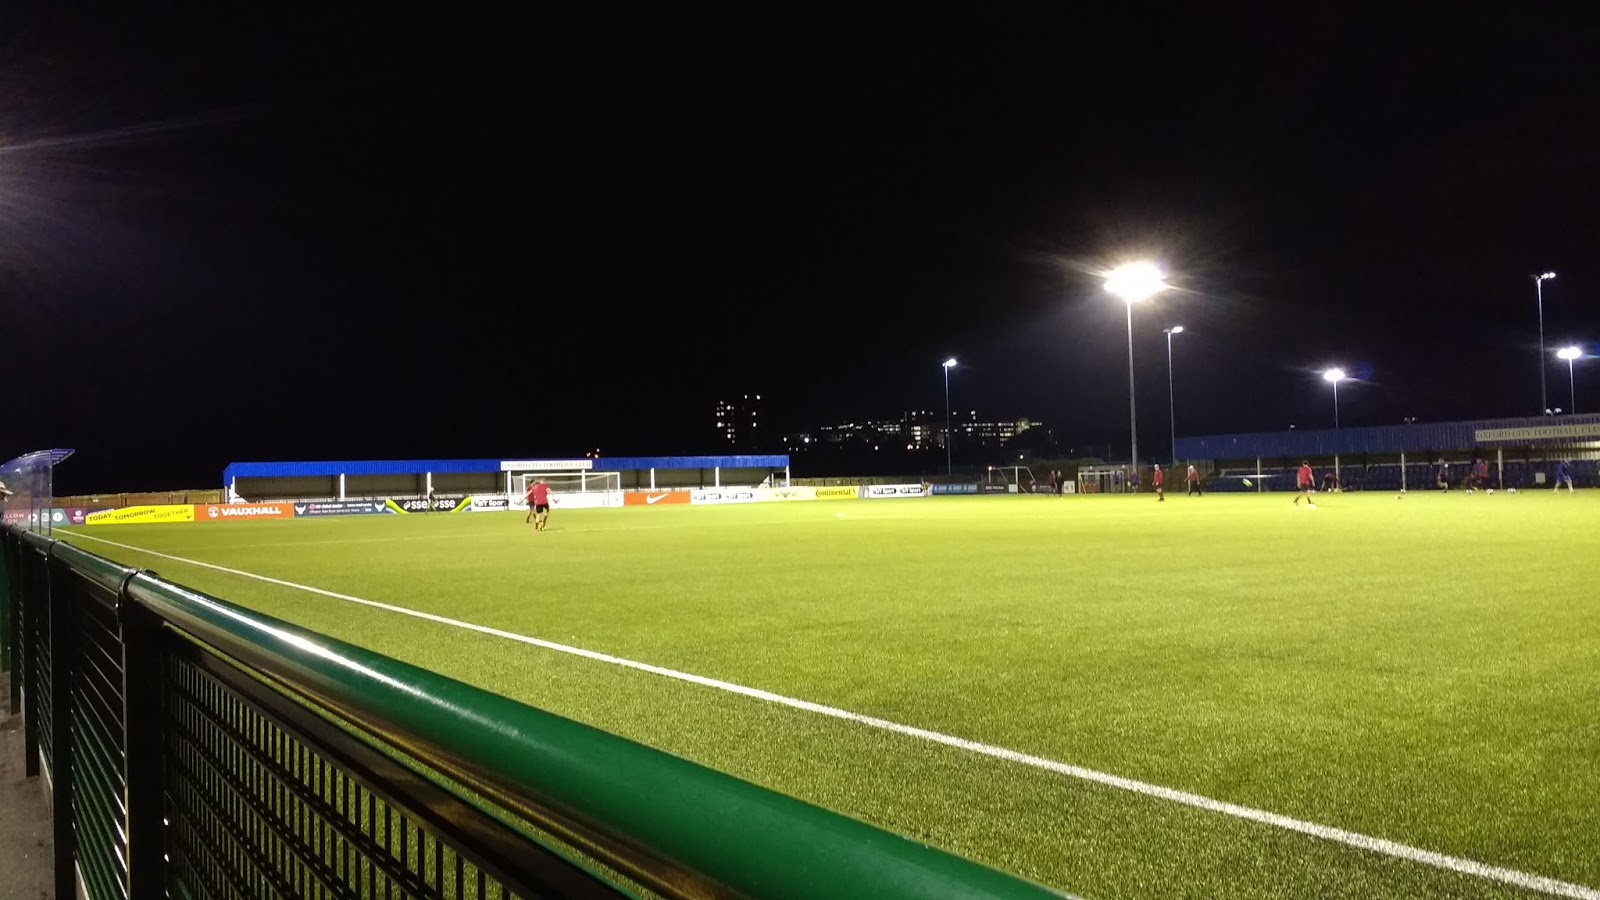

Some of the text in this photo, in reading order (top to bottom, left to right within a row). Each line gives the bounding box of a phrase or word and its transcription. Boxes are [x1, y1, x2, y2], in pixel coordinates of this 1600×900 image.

[1581, 425, 1600, 433] CLU
[815, 488, 851, 497] Continental
[411, 500, 428, 509] sse
[439, 499, 456, 508] sse
[221, 506, 282, 516] VAUXHALL
